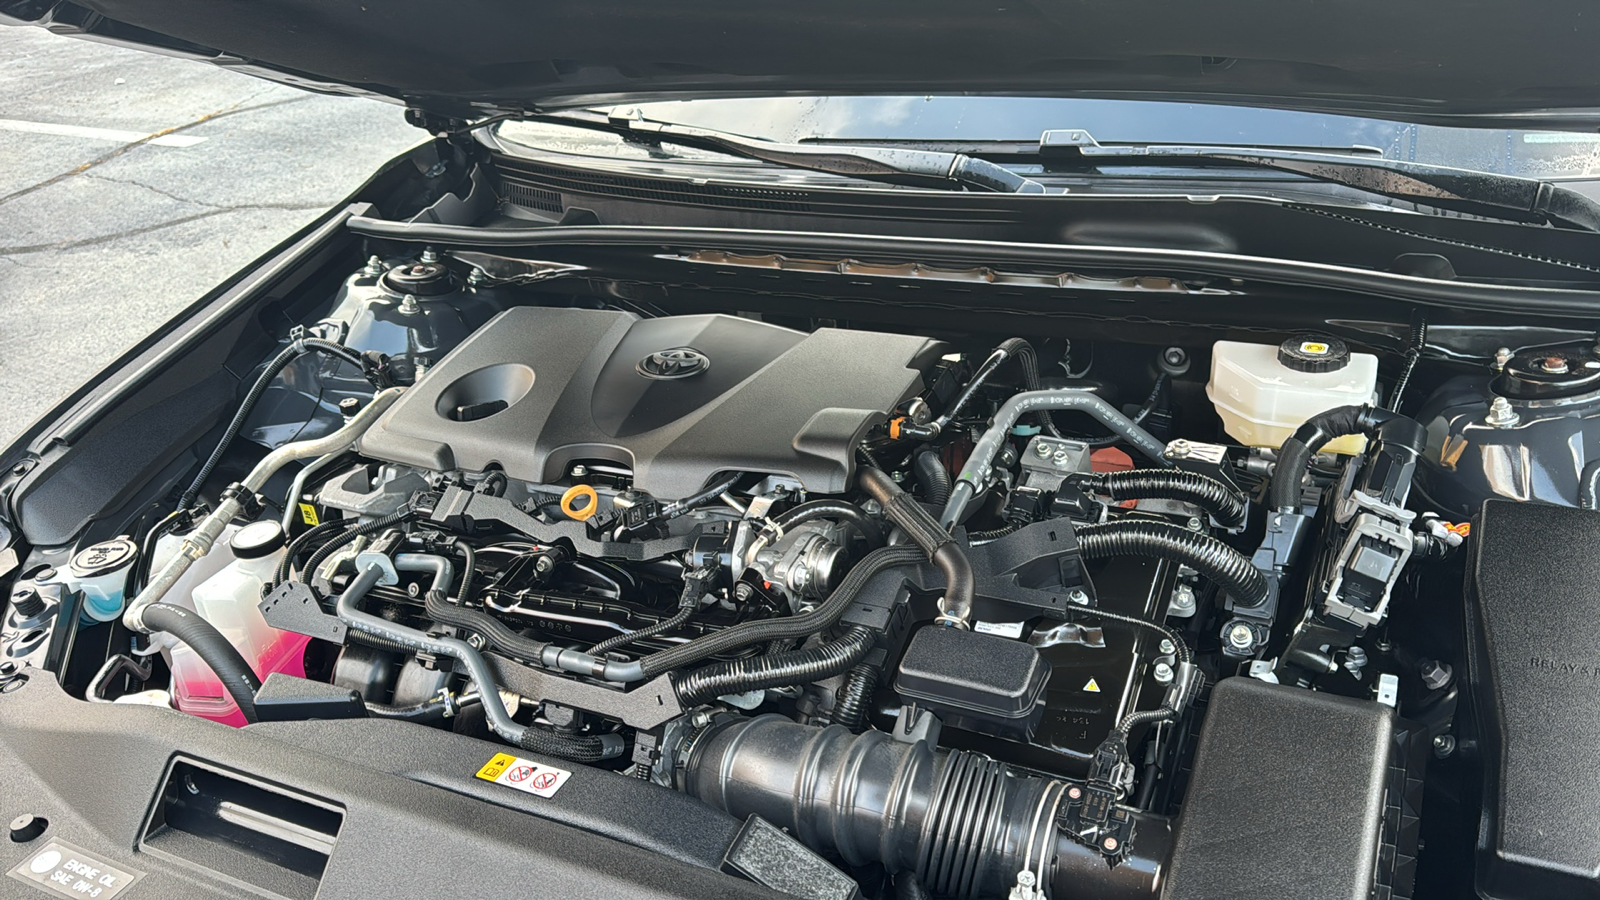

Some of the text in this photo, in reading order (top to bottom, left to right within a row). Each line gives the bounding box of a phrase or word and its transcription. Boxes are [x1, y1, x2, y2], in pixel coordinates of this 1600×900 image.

[1531, 657, 1578, 673] RELAY
[51, 870, 74, 885] SAE
[63, 859, 116, 887] ENGINE OIL
